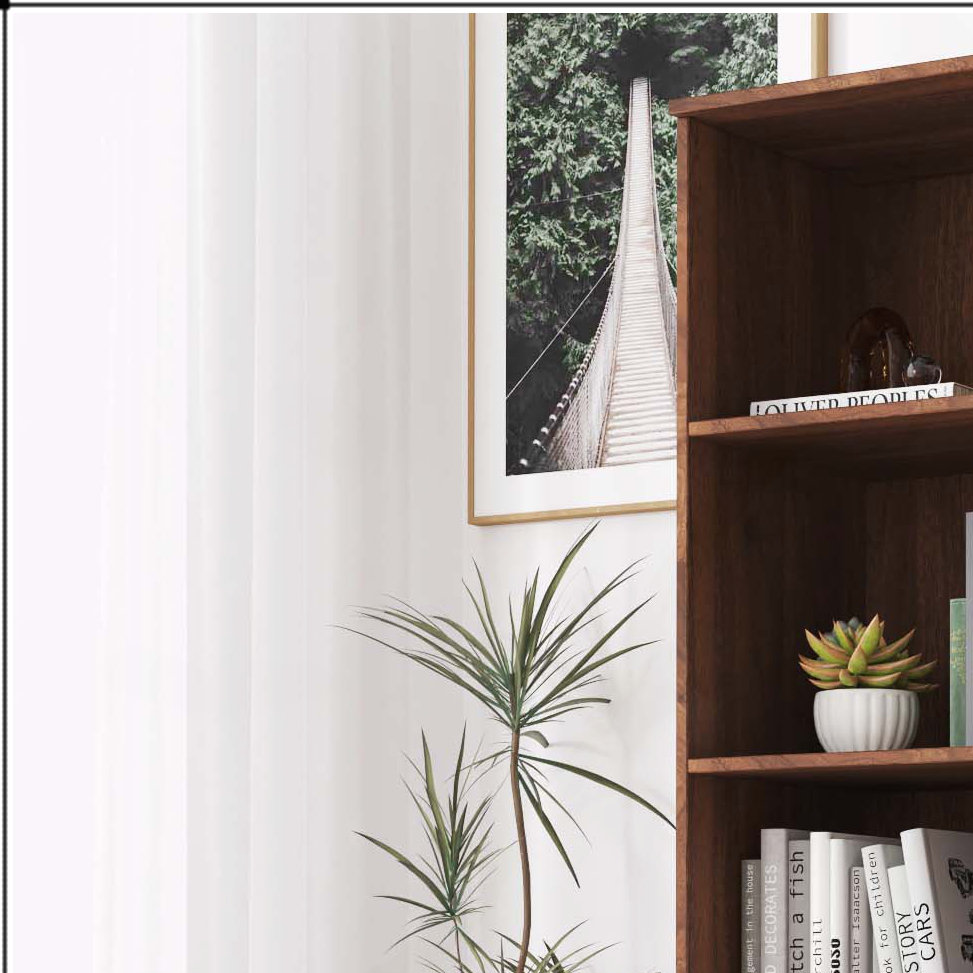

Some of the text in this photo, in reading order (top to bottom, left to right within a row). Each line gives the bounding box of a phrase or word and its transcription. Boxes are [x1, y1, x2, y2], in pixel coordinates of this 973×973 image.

[746, 864, 754, 893] house
[790, 851, 804, 897] fish
[852, 869, 860, 930] Isaacson
[868, 852, 885, 917] children
[764, 864, 778, 960] DECORATES
[793, 913, 804, 924] a
[879, 927, 887, 948] for
[914, 903, 936, 960] CARS
